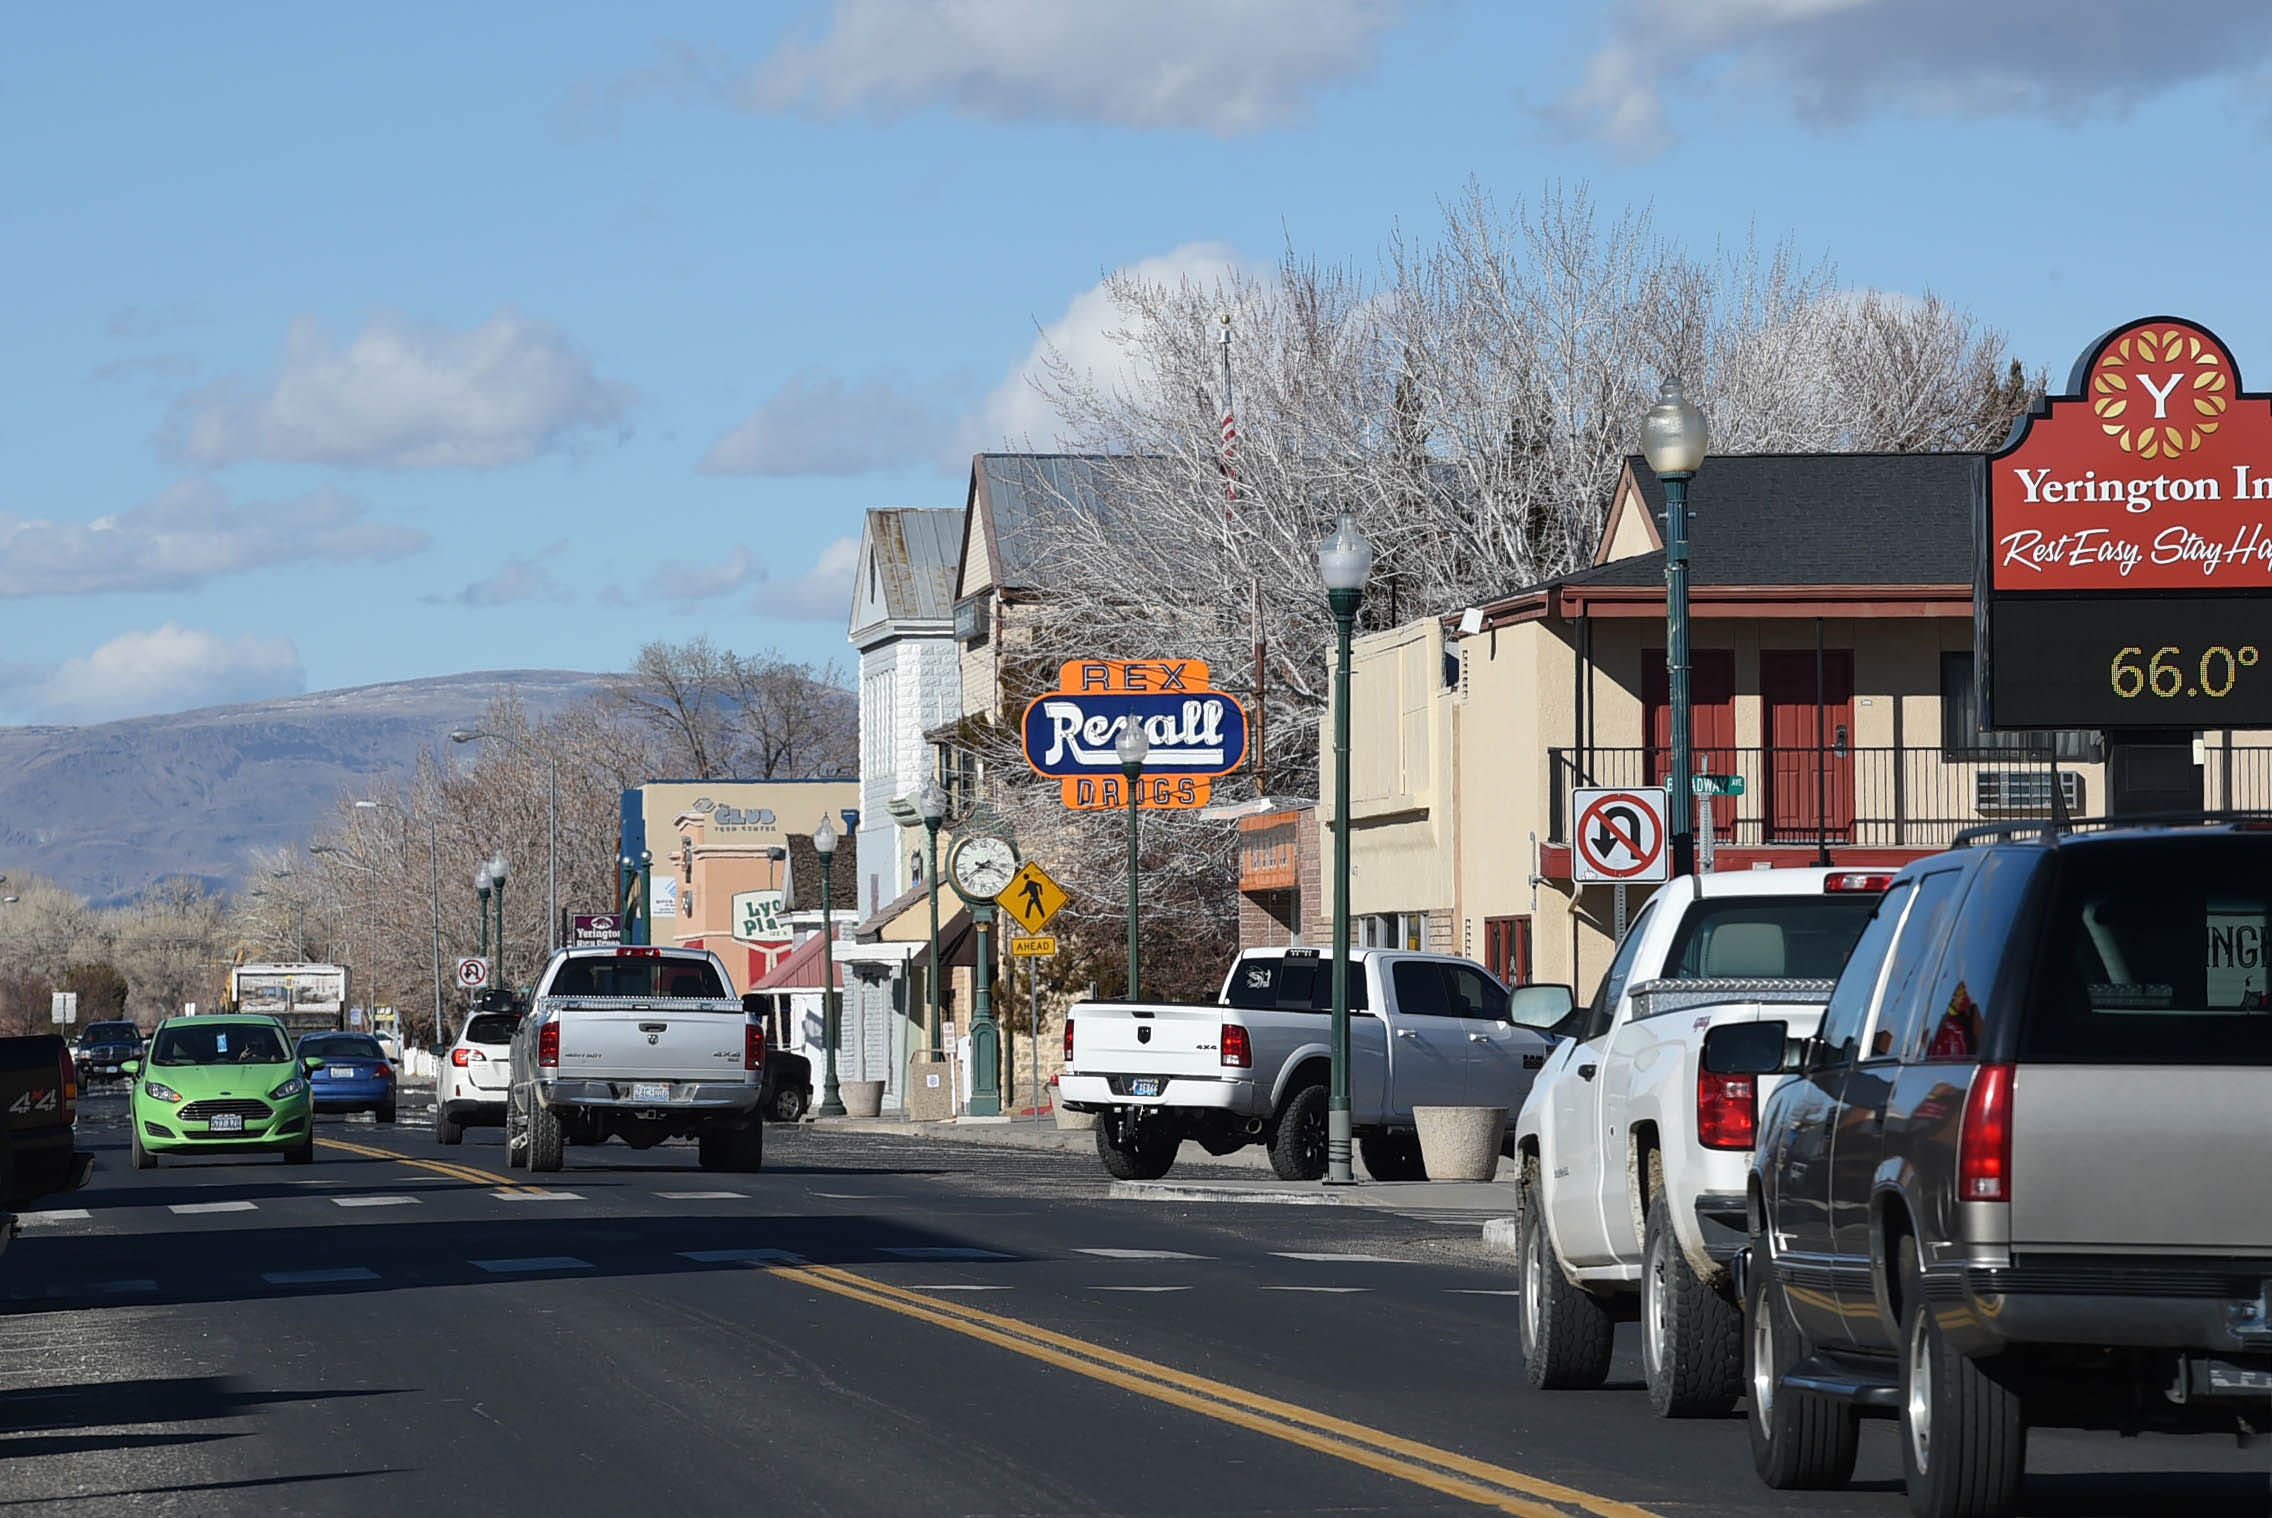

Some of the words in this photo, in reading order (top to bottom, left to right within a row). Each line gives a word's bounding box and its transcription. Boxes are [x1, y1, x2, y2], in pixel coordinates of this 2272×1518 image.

[2135, 373, 2185, 420] Y
[2013, 467, 2222, 514] Yerington
[2000, 529, 2076, 573] Rest
[2068, 528, 2144, 577] Easy.
[2150, 526, 2223, 577] Stay
[1081, 663, 1187, 691] REX
[2110, 646, 2259, 698] 66.0°
[1730, 778, 1743, 787] AVE
[713, 807, 777, 826] CLUB
[1015, 940, 1051, 952] AHEAD
